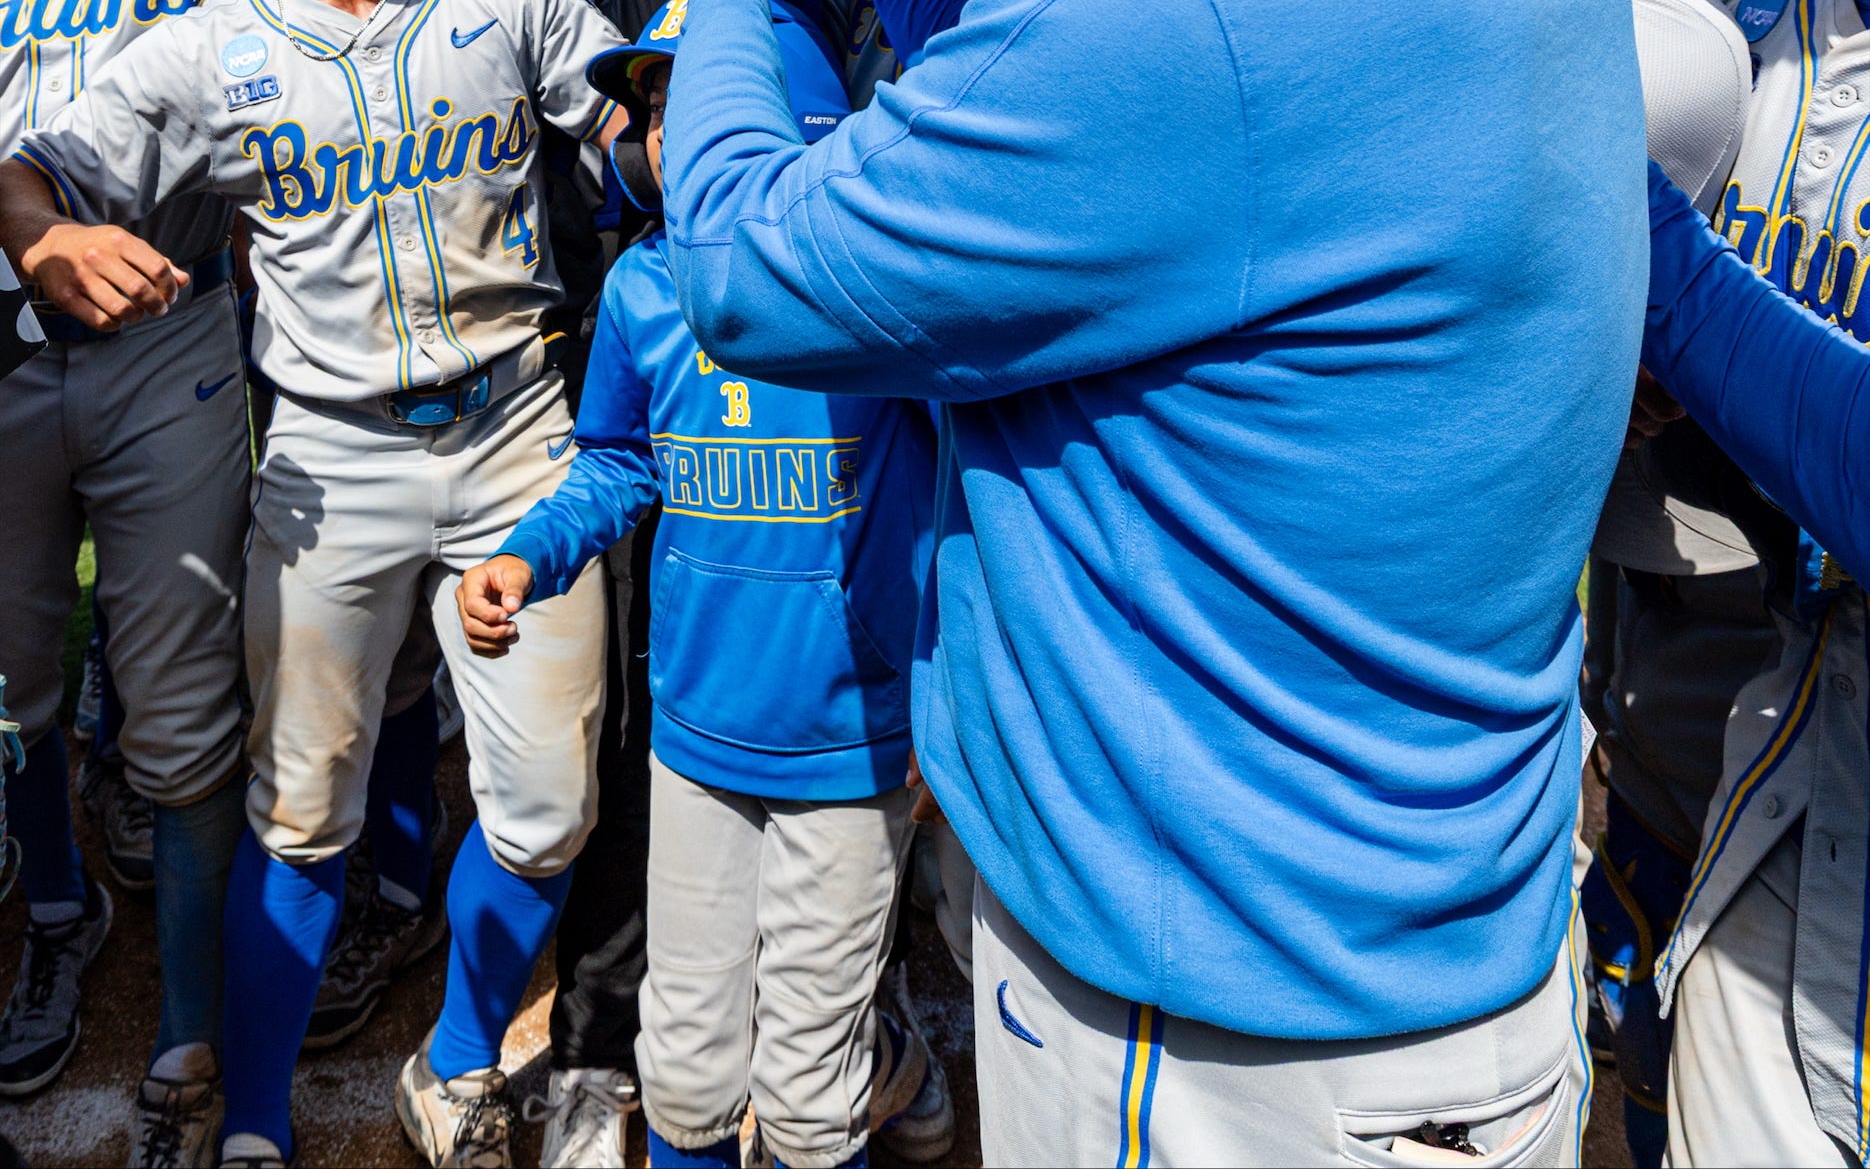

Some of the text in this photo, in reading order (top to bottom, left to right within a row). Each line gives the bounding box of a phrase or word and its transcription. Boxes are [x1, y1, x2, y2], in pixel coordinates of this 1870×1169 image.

[804, 115, 837, 126] EASTON
[240, 96, 538, 223] Bruins
[500, 181, 541, 271] 4
[720, 381, 750, 427] B
